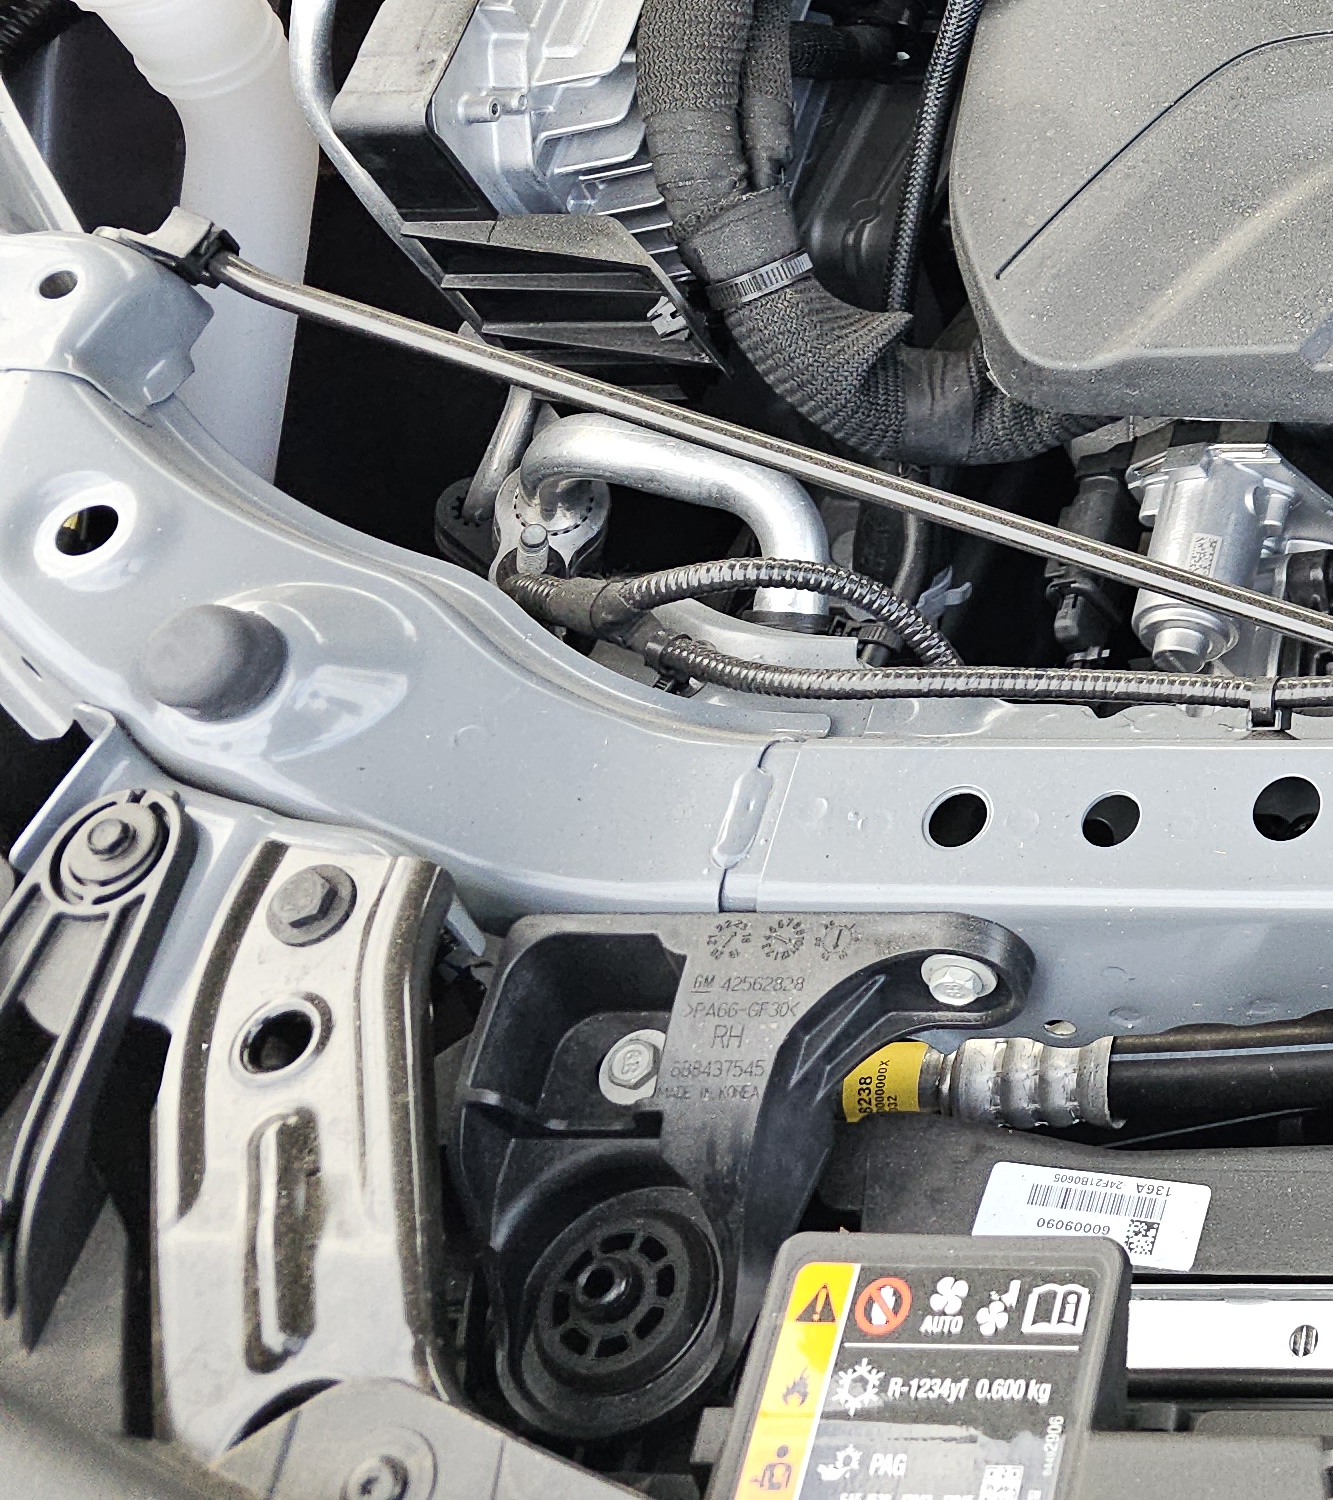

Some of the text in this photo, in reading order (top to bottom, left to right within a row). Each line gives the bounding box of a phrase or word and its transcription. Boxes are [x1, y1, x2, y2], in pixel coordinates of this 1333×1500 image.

[721, 976, 805, 991] 42562828
[711, 1025, 745, 1048] RH
[1136, 1183, 1172, 1197] 136A
[1036, 1217, 1111, 1236] 60009090
[919, 1315, 964, 1334] AUTO
[887, 1377, 1052, 1405] R-1234yf 0.600 kg
[869, 1453, 908, 1477] PAG
